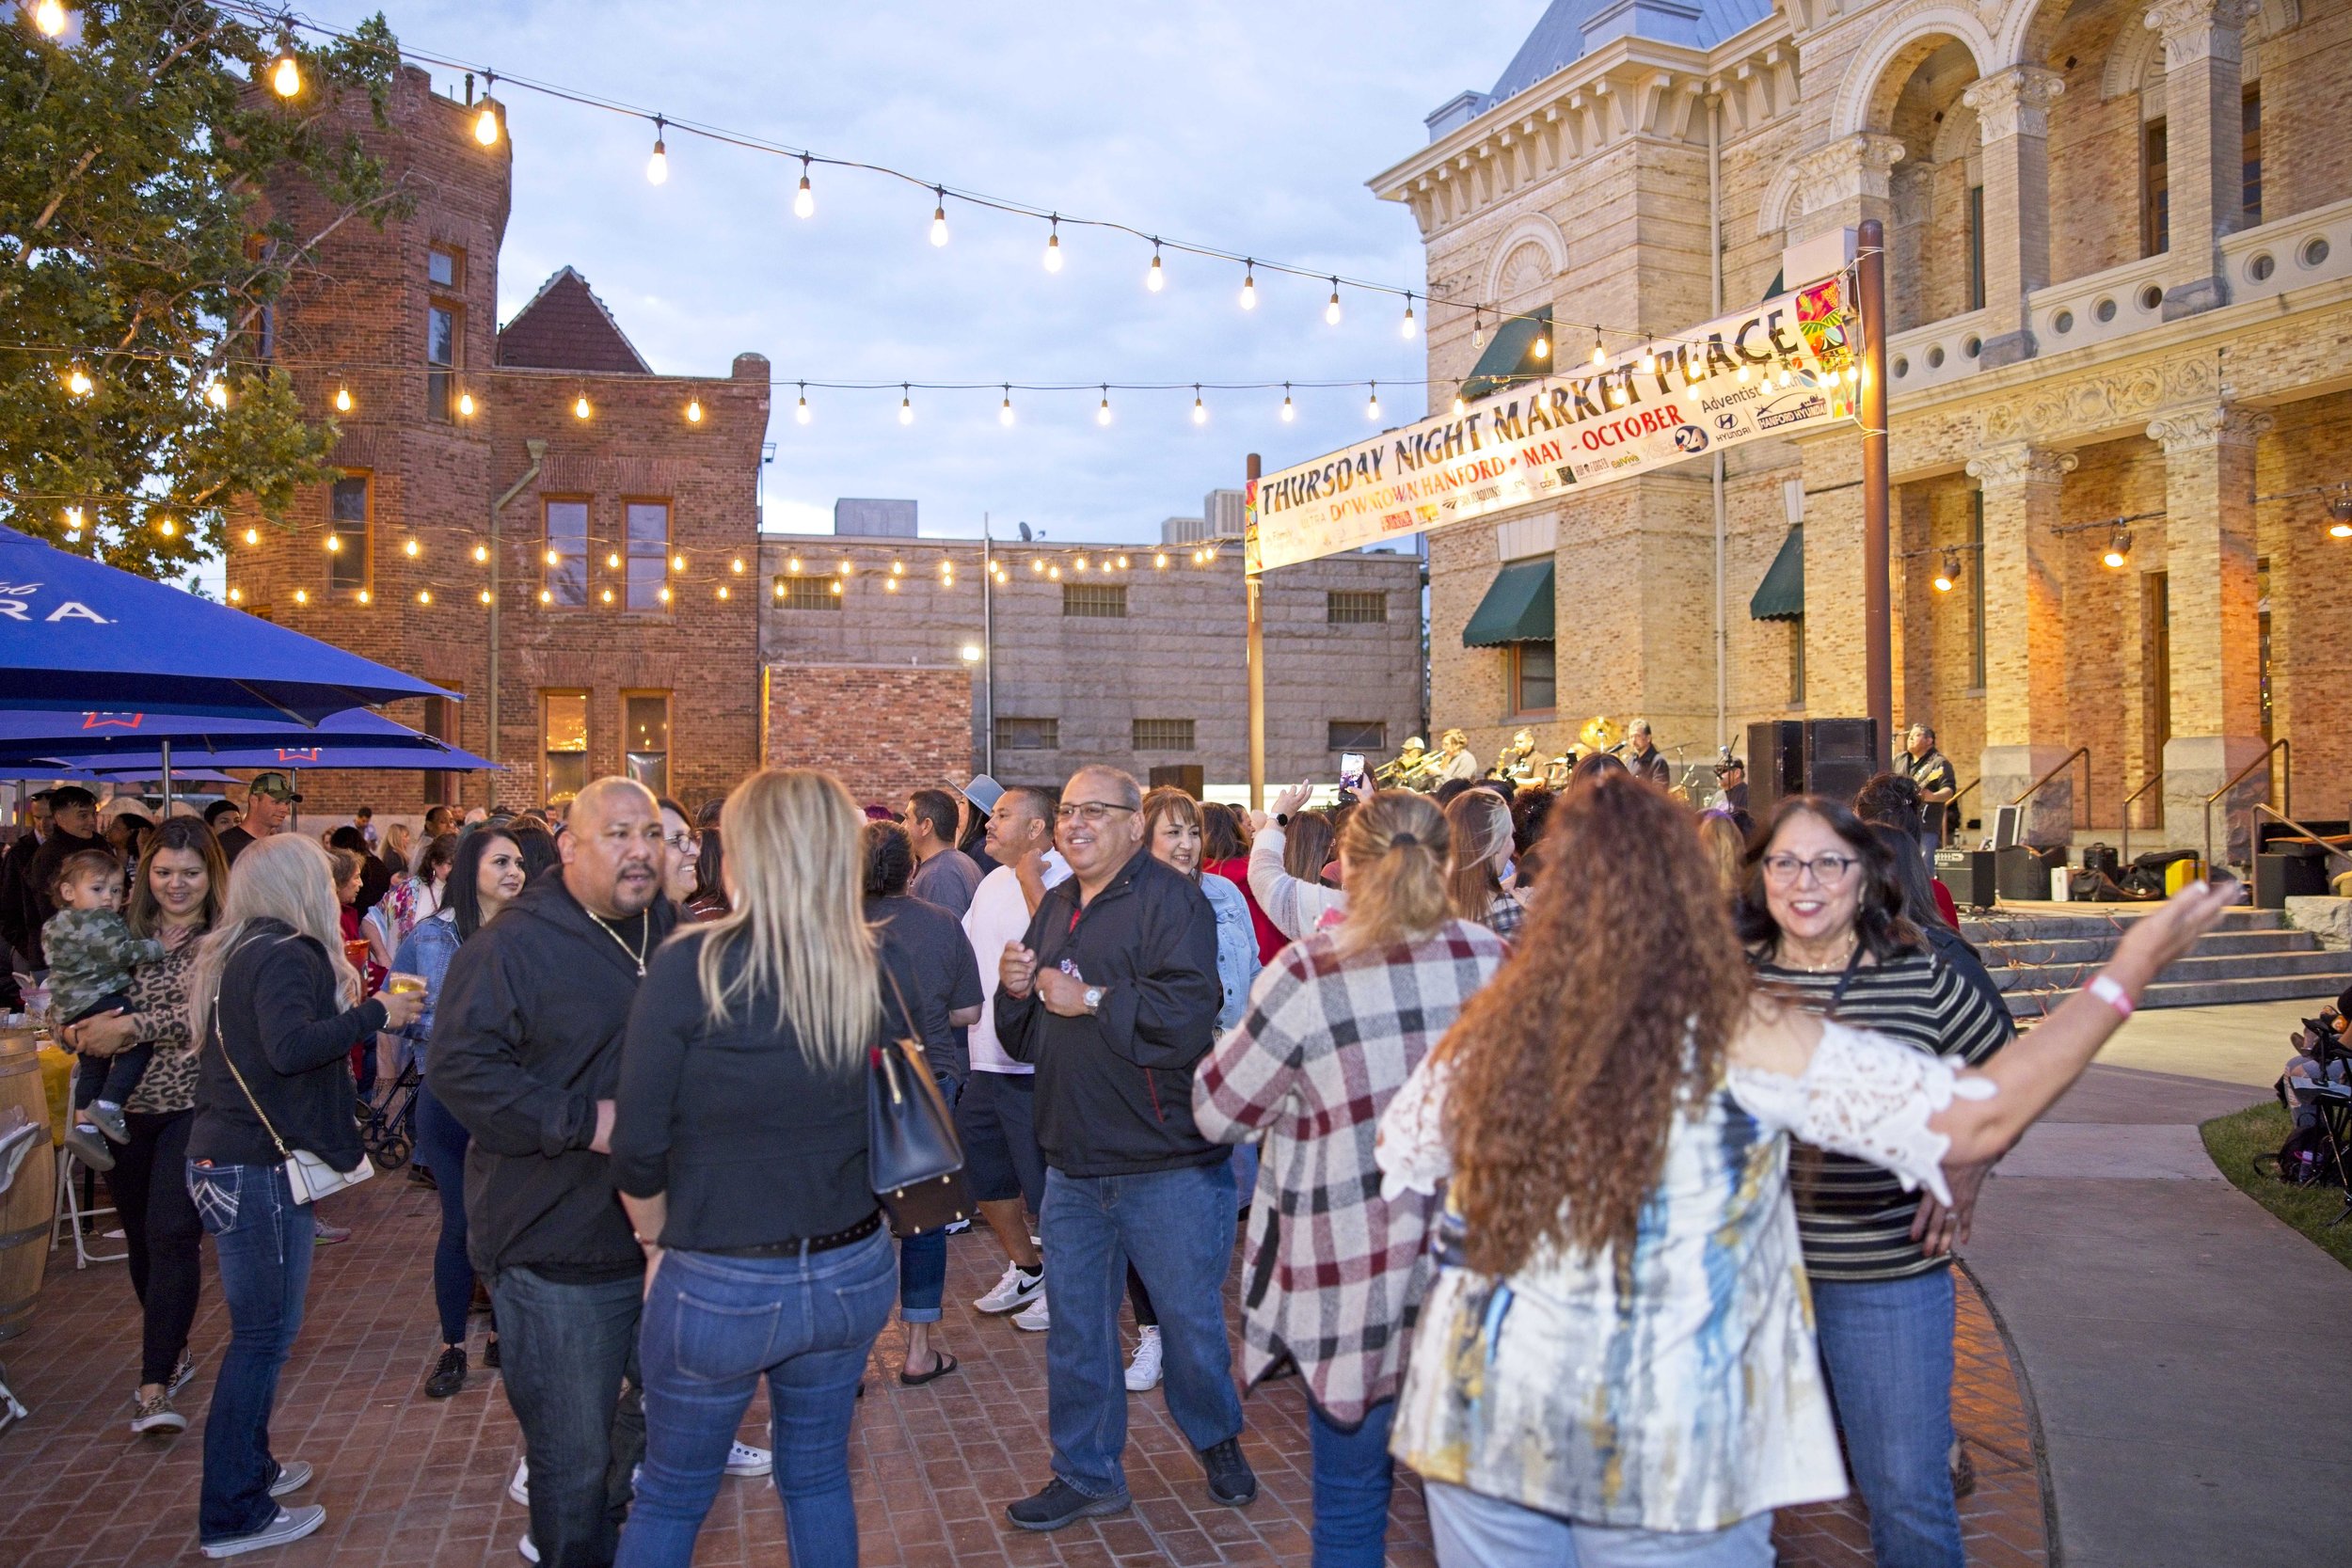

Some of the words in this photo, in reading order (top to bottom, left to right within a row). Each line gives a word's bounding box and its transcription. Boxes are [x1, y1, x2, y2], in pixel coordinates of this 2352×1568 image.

[1262, 445, 1384, 516] THURSDAY
[1395, 412, 1484, 475] NIGHT
[1494, 359, 1642, 444] MARKET
[1655, 309, 1799, 395] PLACE
[1701, 383, 1762, 414] Adventist
[1758, 412, 1795, 429] HANFORD
[1794, 404, 1827, 420] HYUNDAI
[1676, 428, 1706, 451] 24
[1716, 426, 1752, 442] HYUNDAI
[1329, 481, 1419, 523] DOWNTOWN
[1422, 456, 1506, 498] HANFORD
[1522, 438, 1564, 468] MAY
[1581, 404, 1685, 451] OCTOBER
